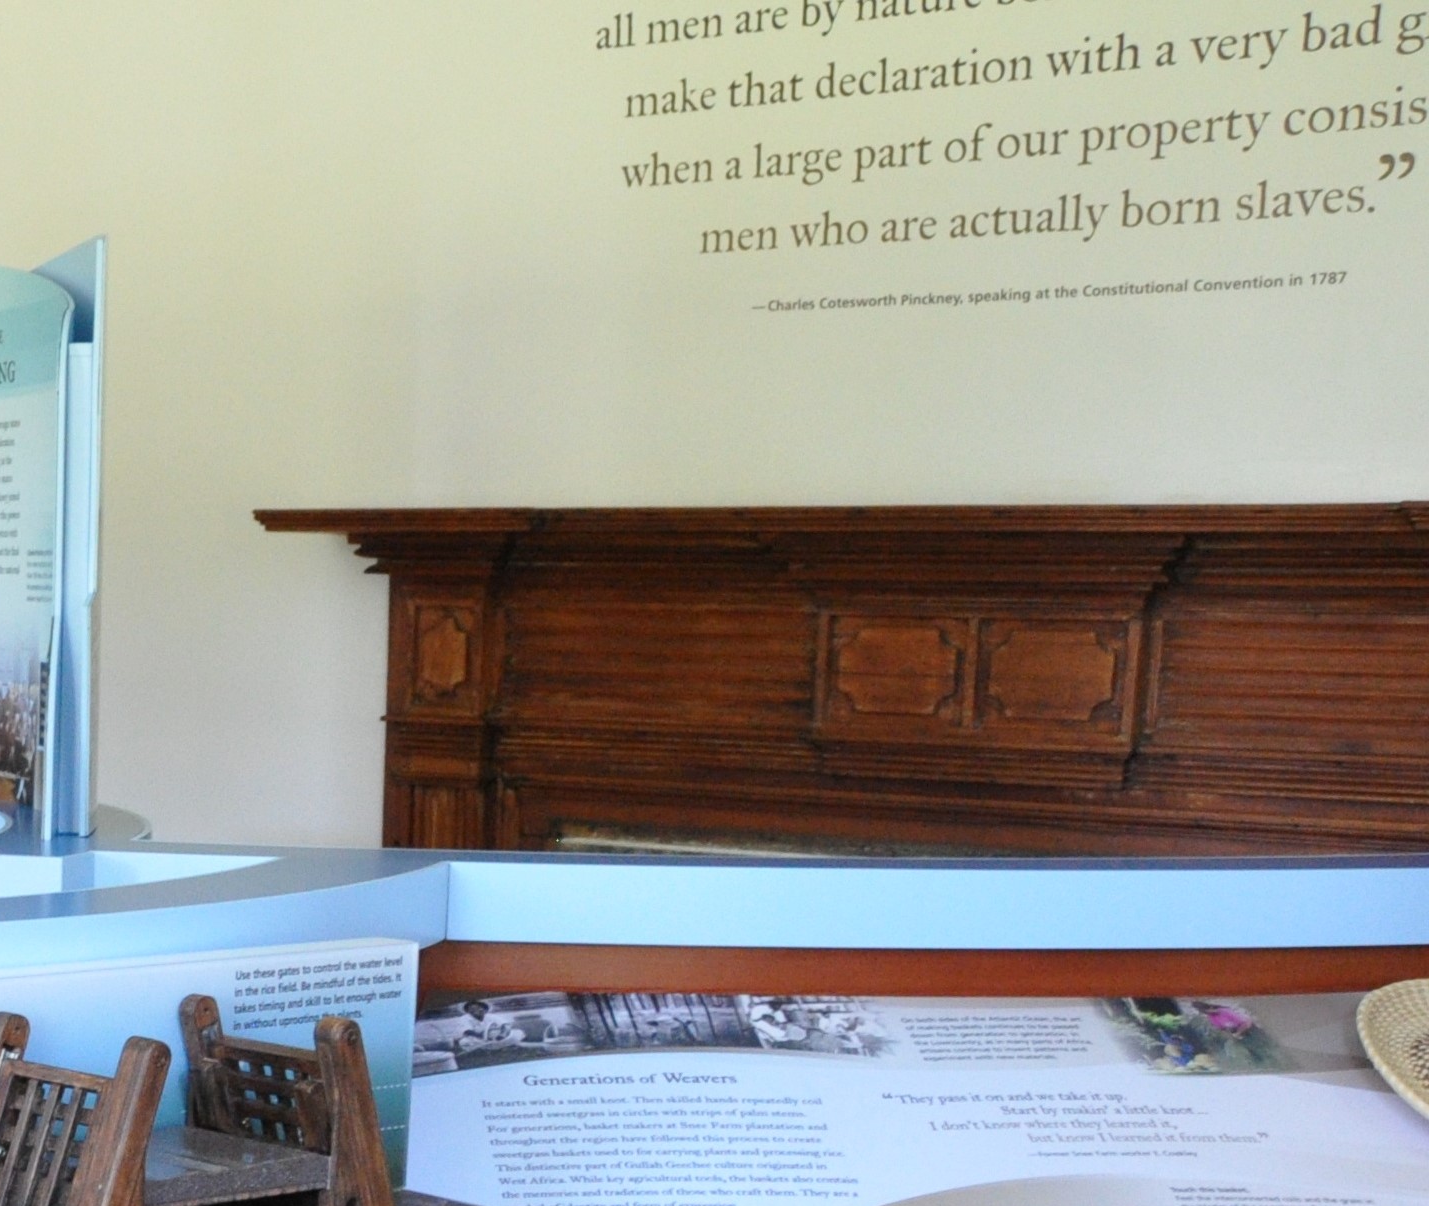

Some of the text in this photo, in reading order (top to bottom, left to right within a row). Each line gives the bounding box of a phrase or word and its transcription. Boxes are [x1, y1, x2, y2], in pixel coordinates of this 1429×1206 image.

[597, 12, 635, 50] all
[648, 15, 722, 44] men
[736, 8, 788, 34] are
[802, 0, 844, 37] by
[626, 4, 1429, 118] make that declaration with a very bad g
[622, 152, 712, 187] when
[725, 158, 742, 180] a
[754, 143, 842, 186] large
[853, 137, 932, 183] part
[944, 122, 993, 163] of
[997, 129, 1069, 159] our
[1078, 110, 1271, 166] property
[701, 227, 778, 254] men
[791, 210, 869, 247] who
[881, 217, 937, 243] are
[950, 194, 1109, 243] actually
[1122, 189, 1220, 228] born
[819, 294, 897, 309] Cotesworth
[901, 293, 963, 307] Pinckney,
[968, 288, 1031, 305] speaking
[1035, 288, 1050, 300] at
[1055, 286, 1078, 299] the
[1083, 280, 1189, 297] Constitutional
[1194, 276, 1284, 292] Convention
[1289, 274, 1303, 286] in
[1311, 271, 1347, 285] 1787
[236, 956, 403, 981] Use these gates to control the water level
[523, 1072, 737, 1086] Generations of Weavers
